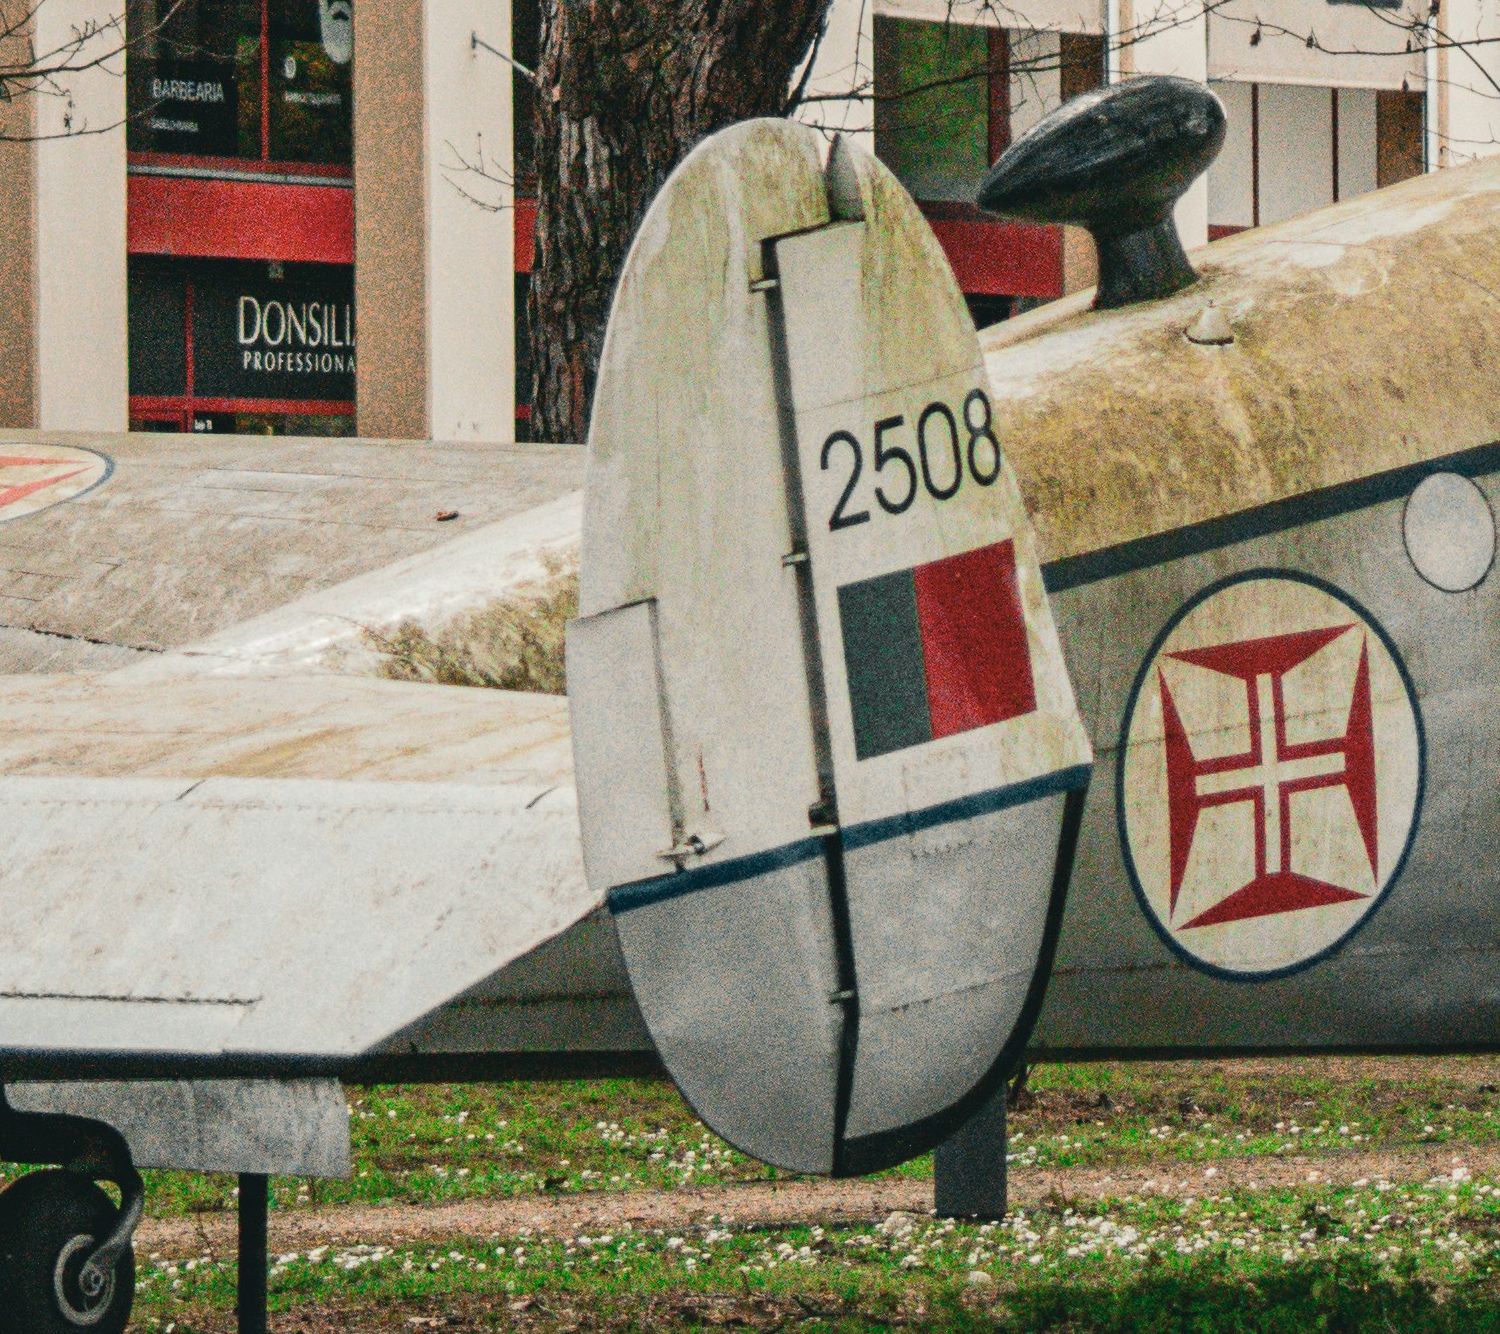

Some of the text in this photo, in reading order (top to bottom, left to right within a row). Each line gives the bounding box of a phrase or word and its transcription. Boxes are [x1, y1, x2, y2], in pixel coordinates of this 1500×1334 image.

[152, 78, 224, 103] BARBEARIA
[238, 295, 356, 347] DONSILI
[820, 388, 1000, 532] 2508
